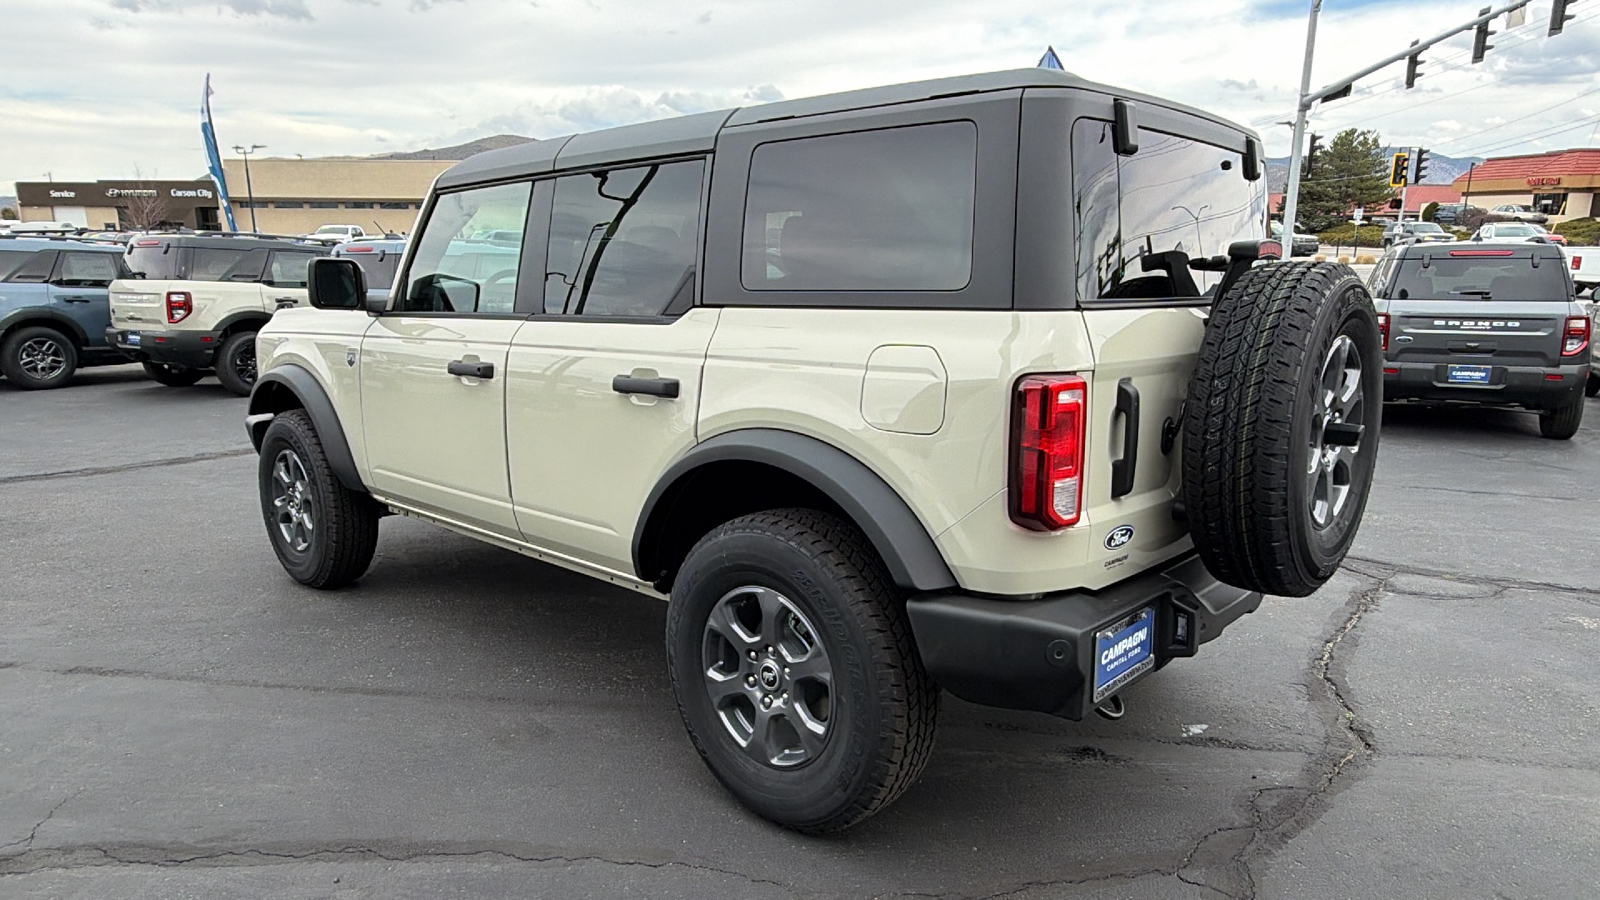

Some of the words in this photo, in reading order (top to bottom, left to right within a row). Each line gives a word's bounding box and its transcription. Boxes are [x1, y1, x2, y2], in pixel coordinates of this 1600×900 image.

[50, 189, 75, 198] Service
[121, 189, 157, 197] HYUNDAI
[170, 189, 196, 197] Carson
[197, 189, 212, 198] City
[1104, 554, 1129, 567] CAMPAGNI
[1101, 627, 1147, 665] CAMPAGNI
[1107, 656, 1127, 672] CAPITAL
[1128, 646, 1141, 659] FORD
[791, 570, 865, 792] BRIDGESTONE
